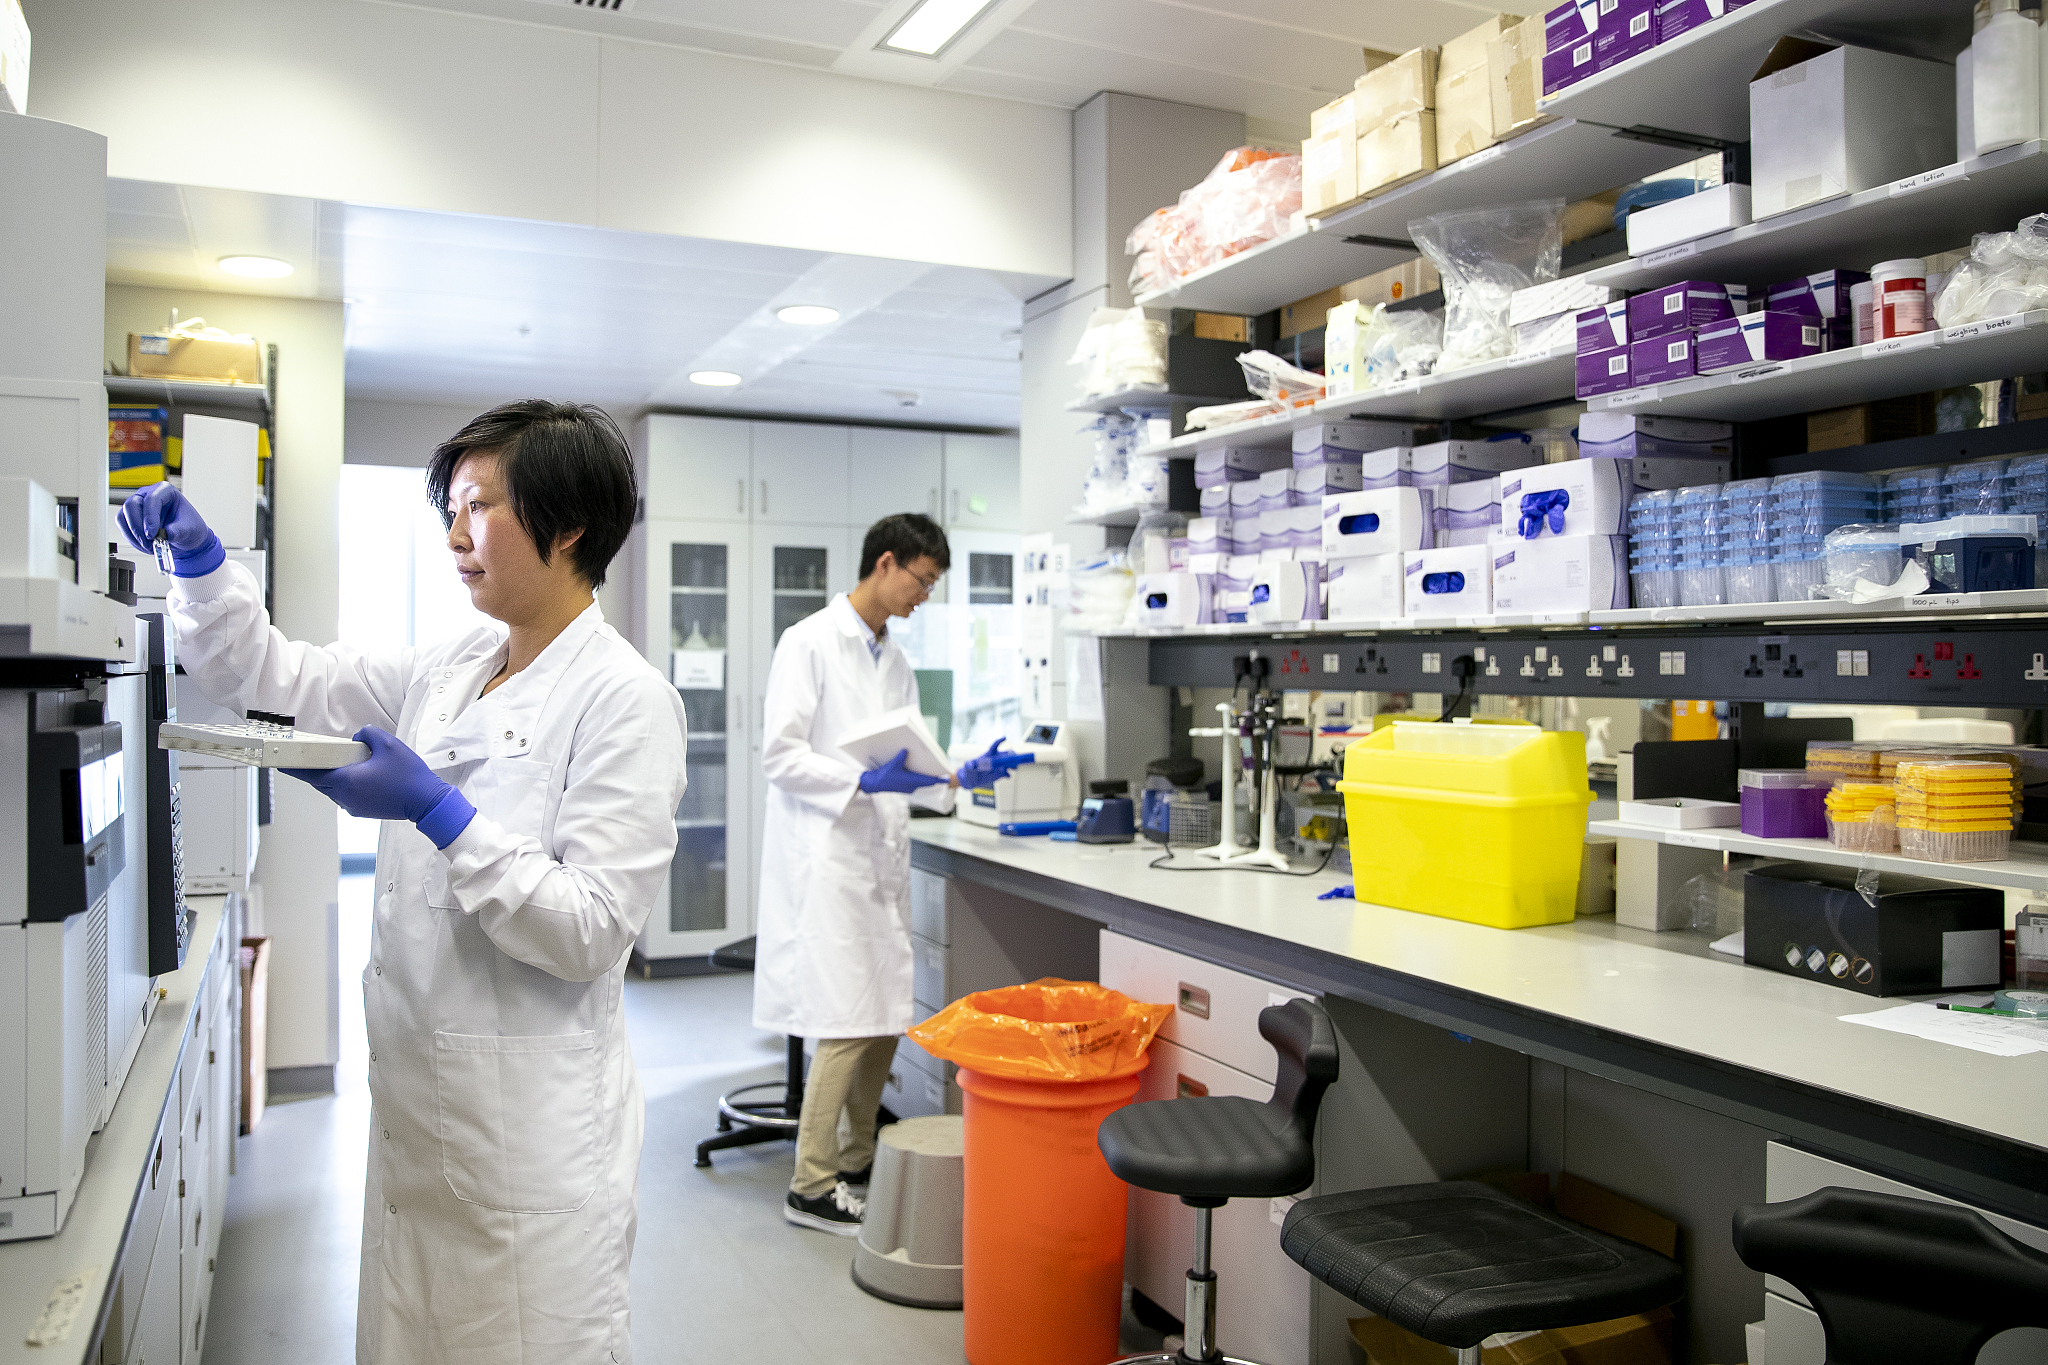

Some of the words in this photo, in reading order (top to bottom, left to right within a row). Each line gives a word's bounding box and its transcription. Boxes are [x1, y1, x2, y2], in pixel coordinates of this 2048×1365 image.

[1899, 180, 1916, 190] hand
[1923, 172, 1945, 183] lotion
[1947, 327, 1979, 338] weighing
[1985, 319, 2012, 331] boats
[1876, 342, 1901, 352] virkon
[1912, 598, 1927, 606] 1000
[1946, 597, 1960, 607] tips
